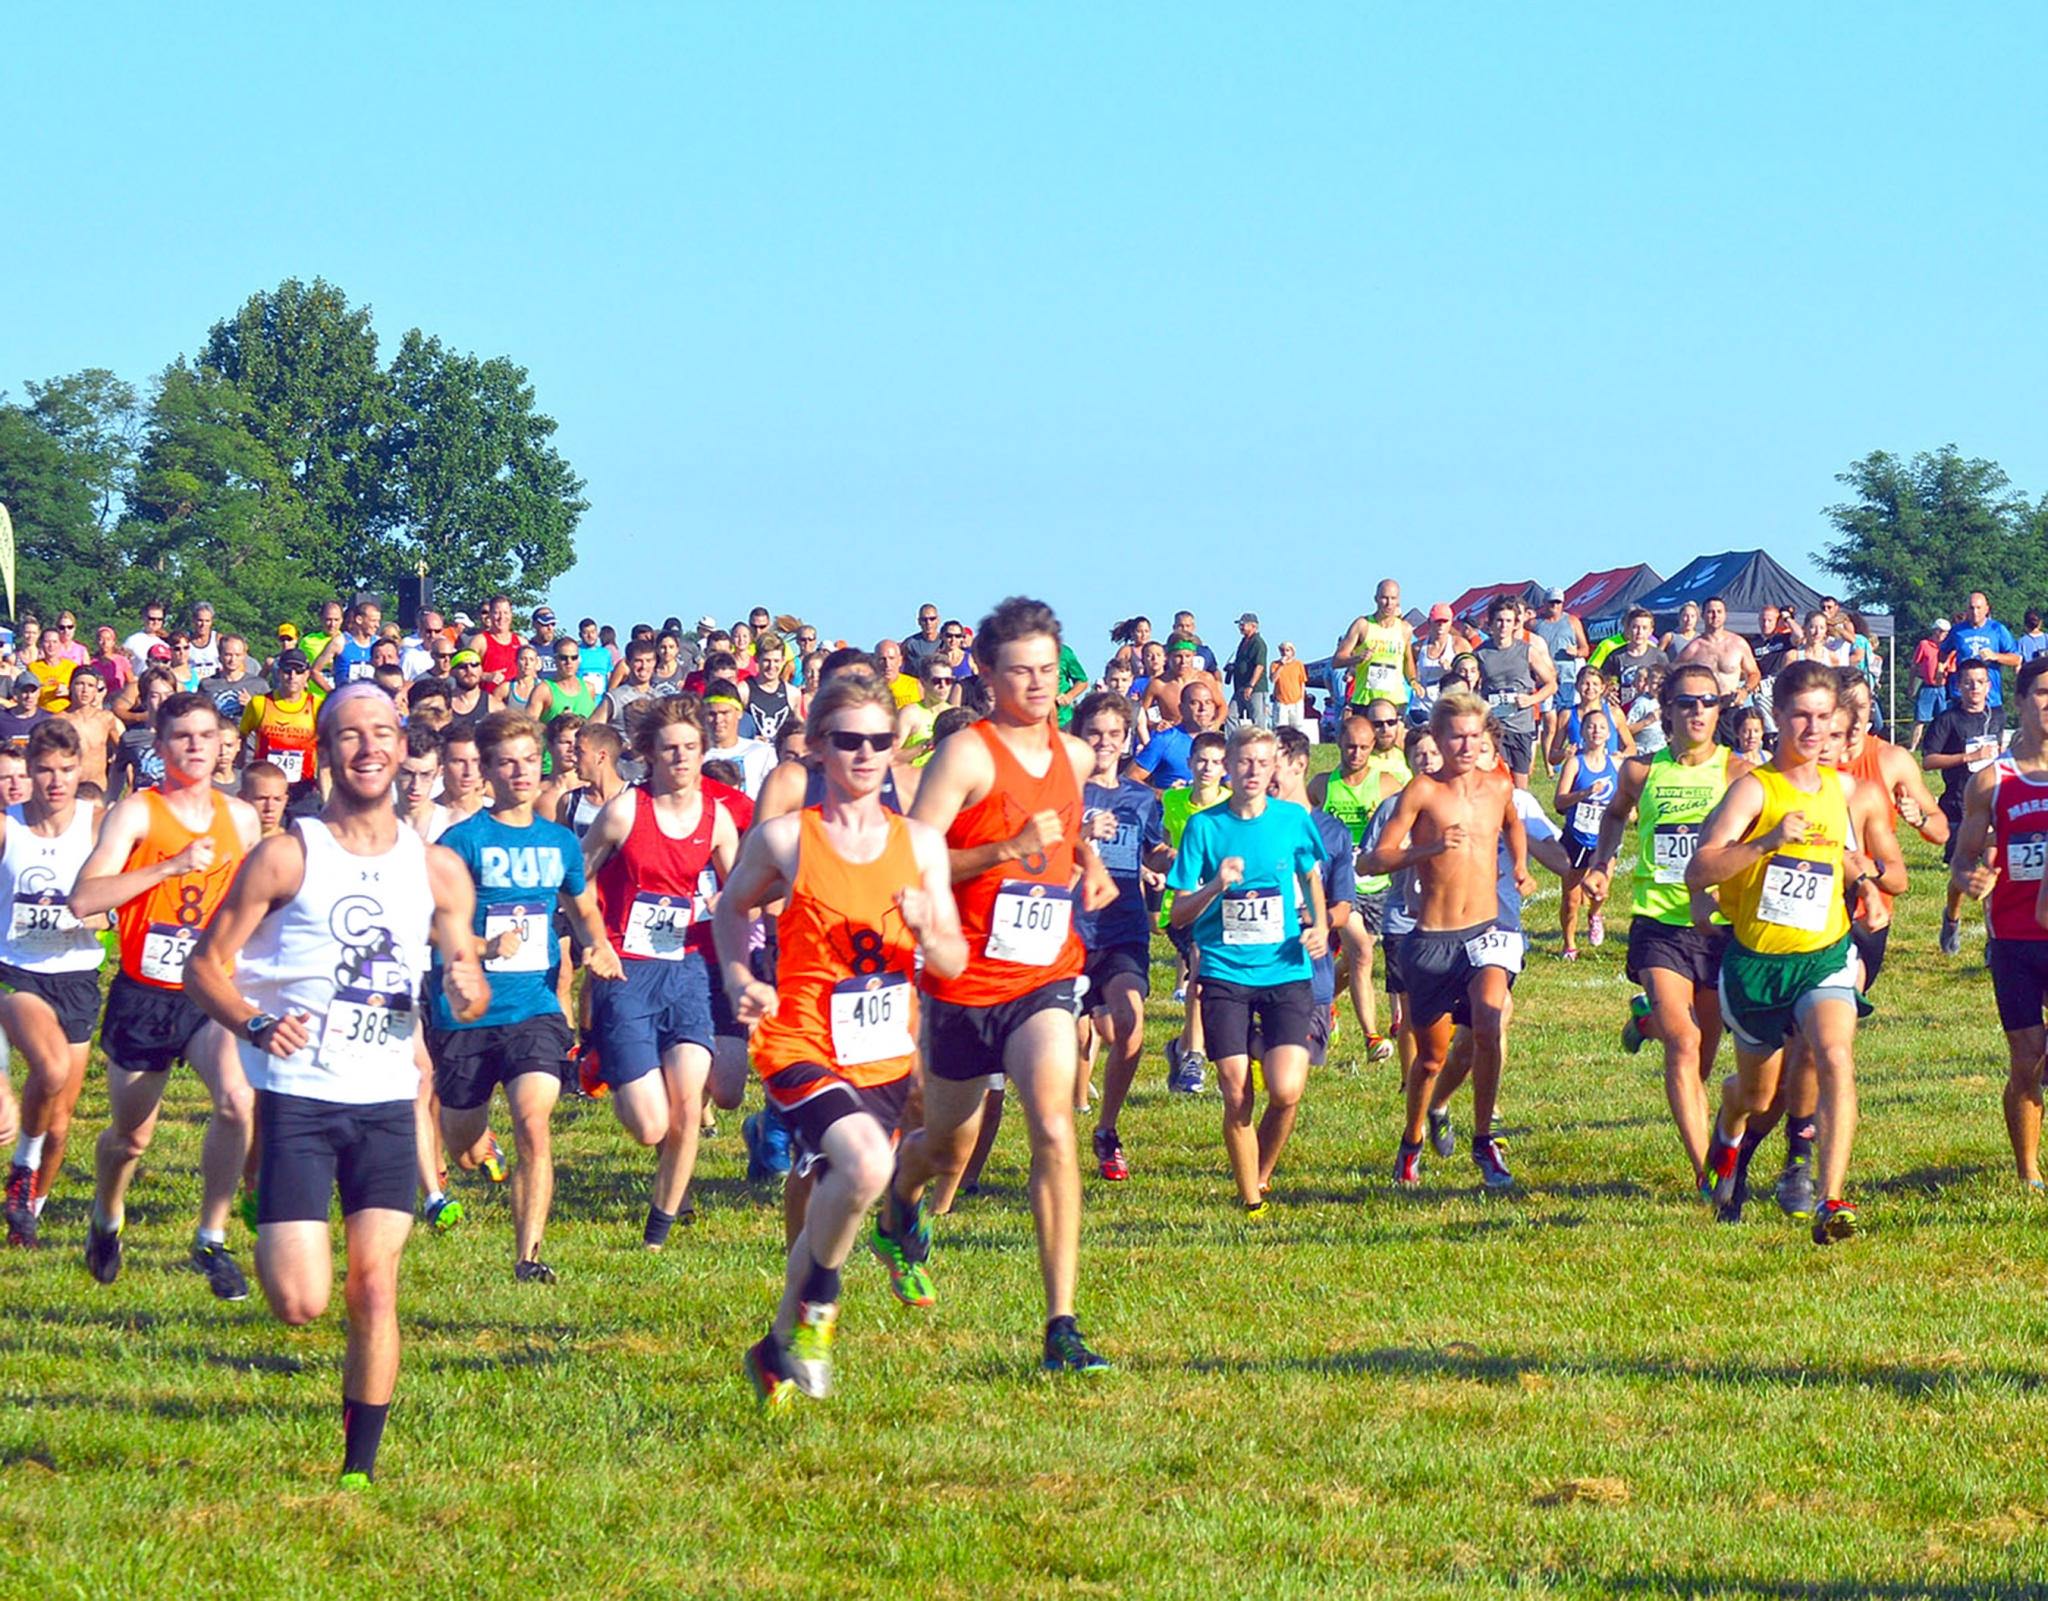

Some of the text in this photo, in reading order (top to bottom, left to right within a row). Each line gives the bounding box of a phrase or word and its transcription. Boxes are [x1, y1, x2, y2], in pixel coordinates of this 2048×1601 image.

[276, 756, 295, 770] 249
[1656, 798, 1708, 818] Racing
[1780, 871, 1818, 901] 228
[28, 908, 61, 930] 387
[1012, 900, 1053, 930] 160
[1236, 900, 1268, 921] 214
[1478, 933, 1508, 950] 357
[853, 992, 891, 1027] 406
[346, 1008, 392, 1046] 388
